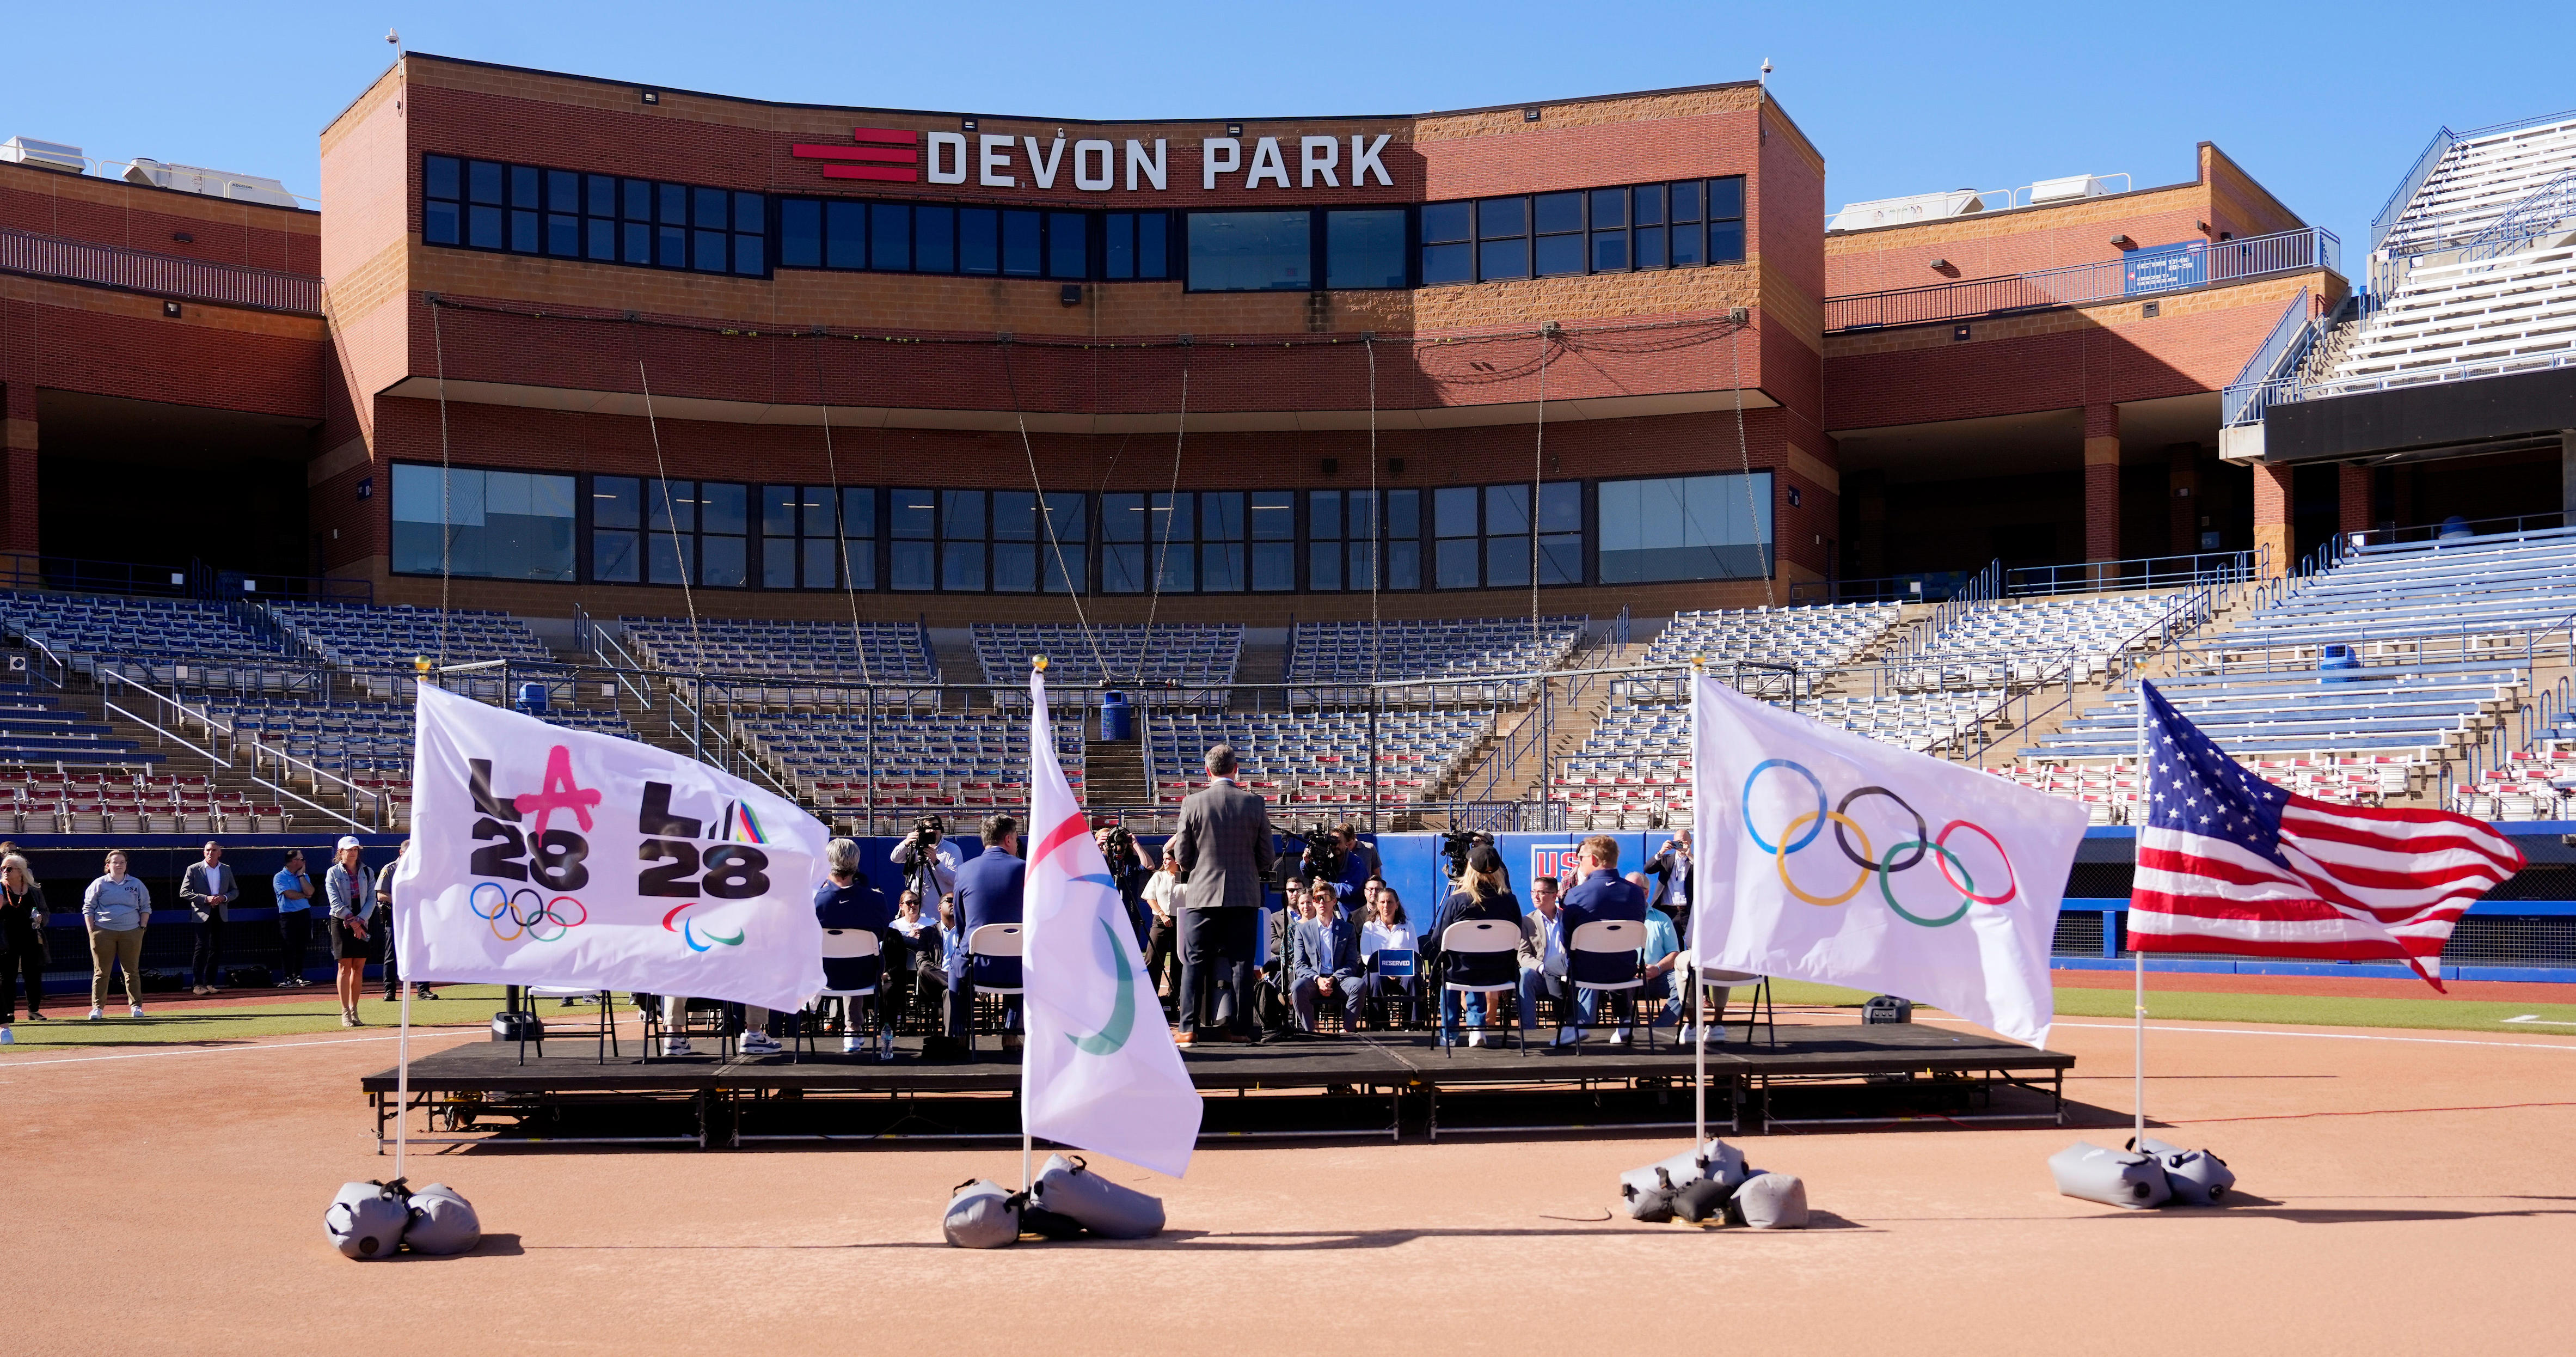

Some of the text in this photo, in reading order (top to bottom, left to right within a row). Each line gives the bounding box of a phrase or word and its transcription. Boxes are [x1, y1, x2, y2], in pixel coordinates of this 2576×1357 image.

[927, 131, 1394, 192] DEVON PARK
[469, 745, 602, 833] LA
[470, 817, 590, 892] 28
[638, 839, 770, 900] 28
[1537, 851, 1579, 878] US
